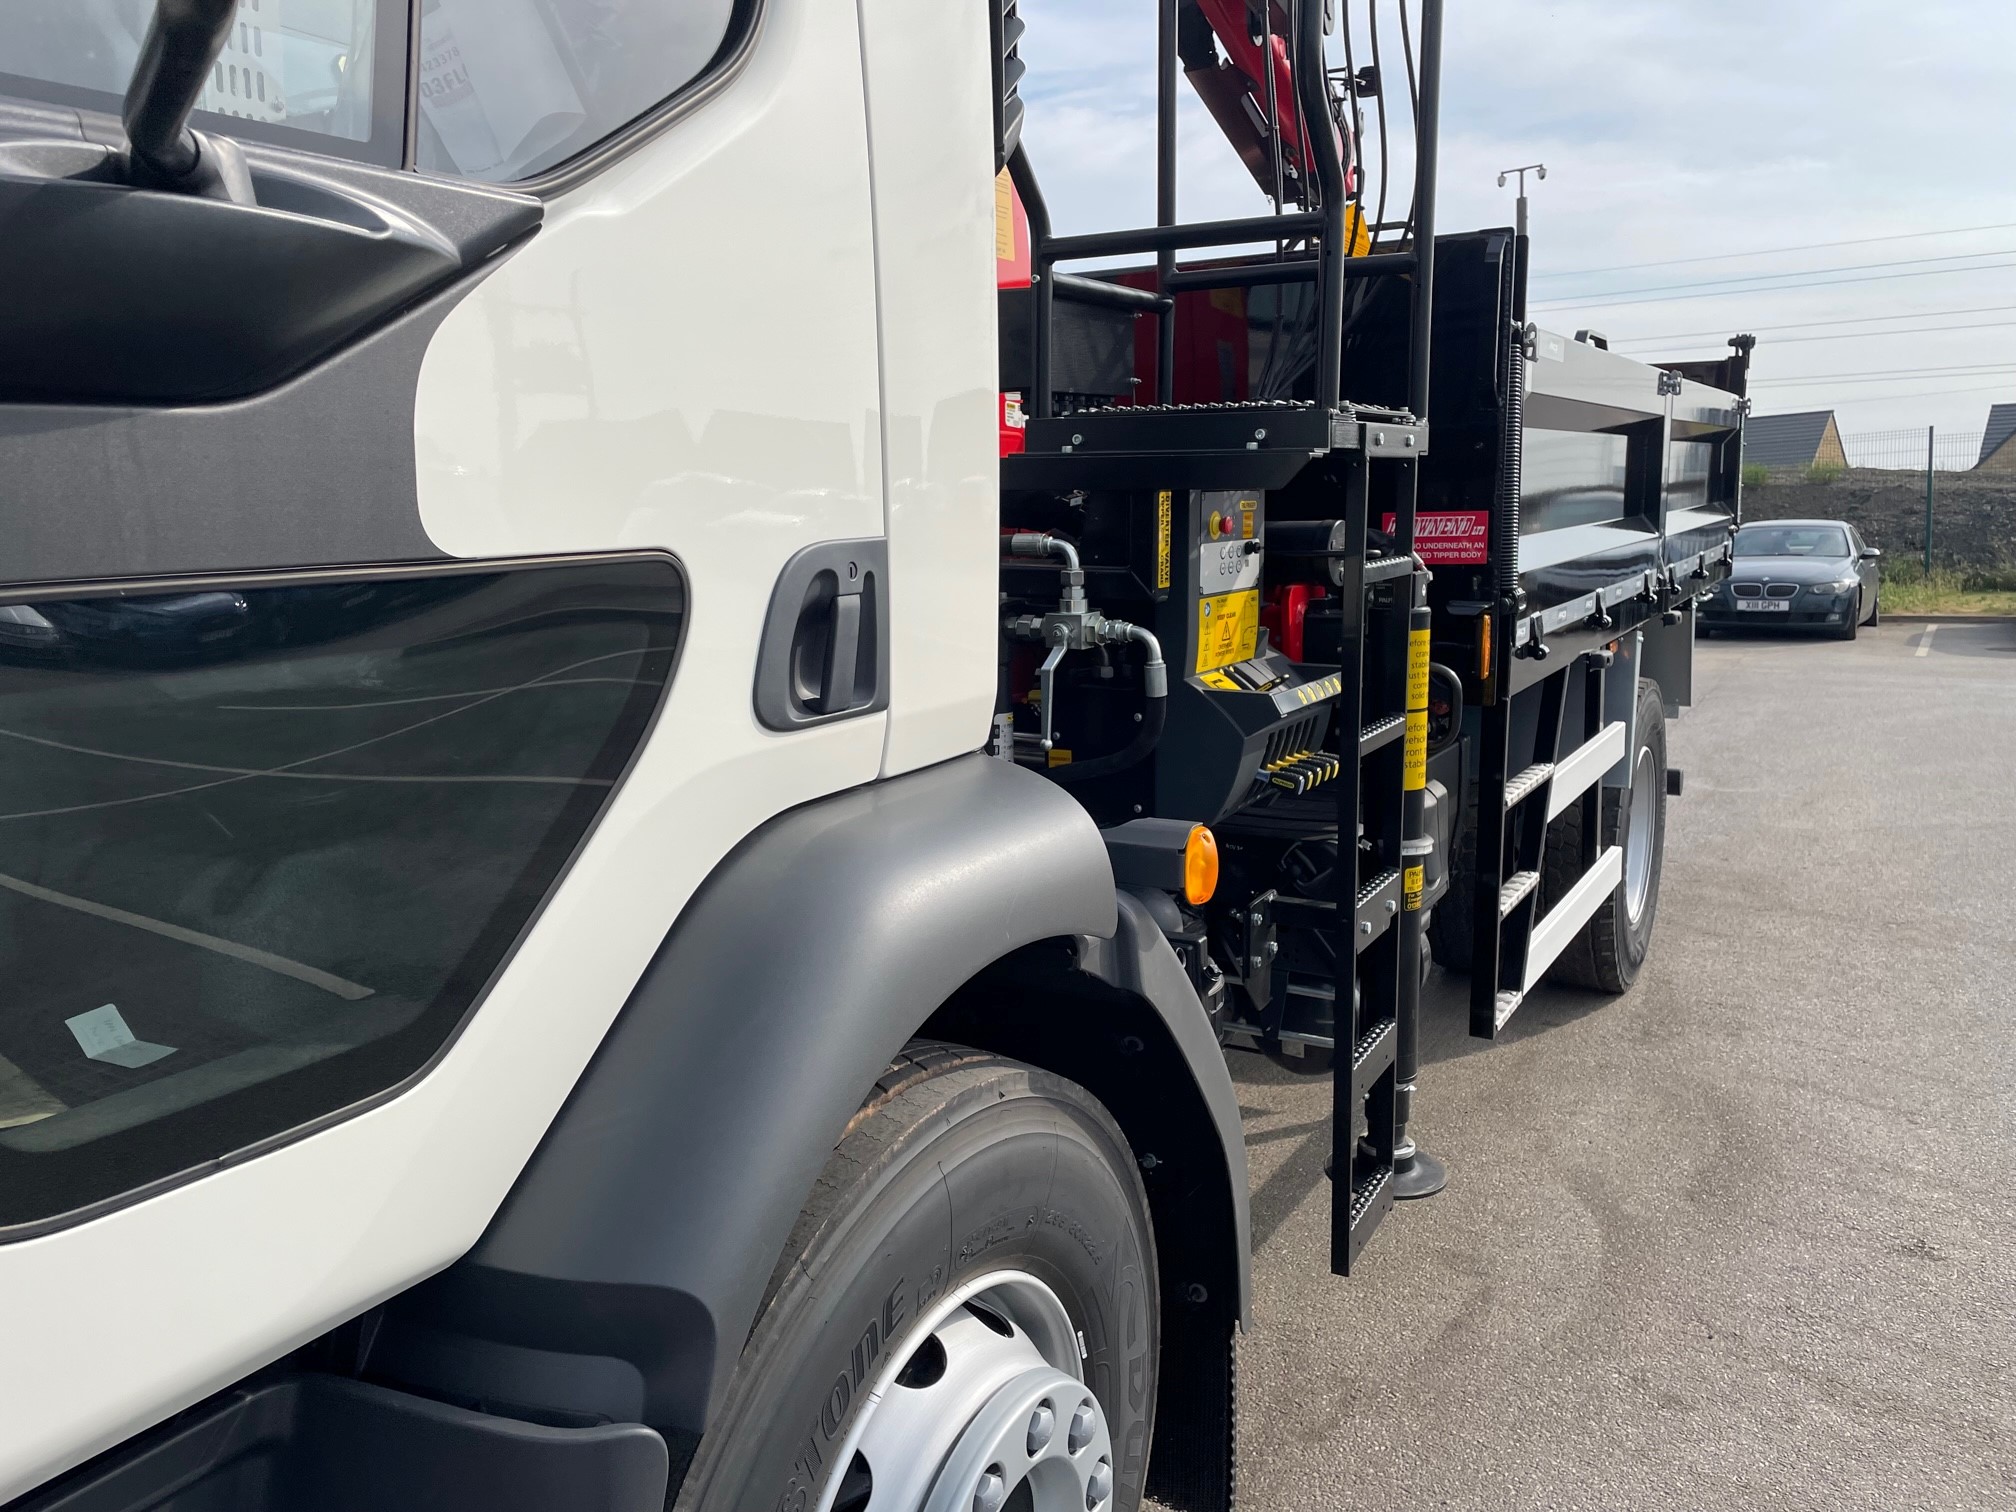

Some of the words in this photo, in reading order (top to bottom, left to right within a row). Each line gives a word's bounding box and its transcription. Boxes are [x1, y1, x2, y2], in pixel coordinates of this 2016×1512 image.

[1423, 542, 1472, 550] UNDERNEATH
[1433, 551, 1460, 559] TIPPER
[1461, 551, 1482, 559] BODY
[1761, 601, 1780, 610] GPH
[1409, 639, 1427, 647] efore
